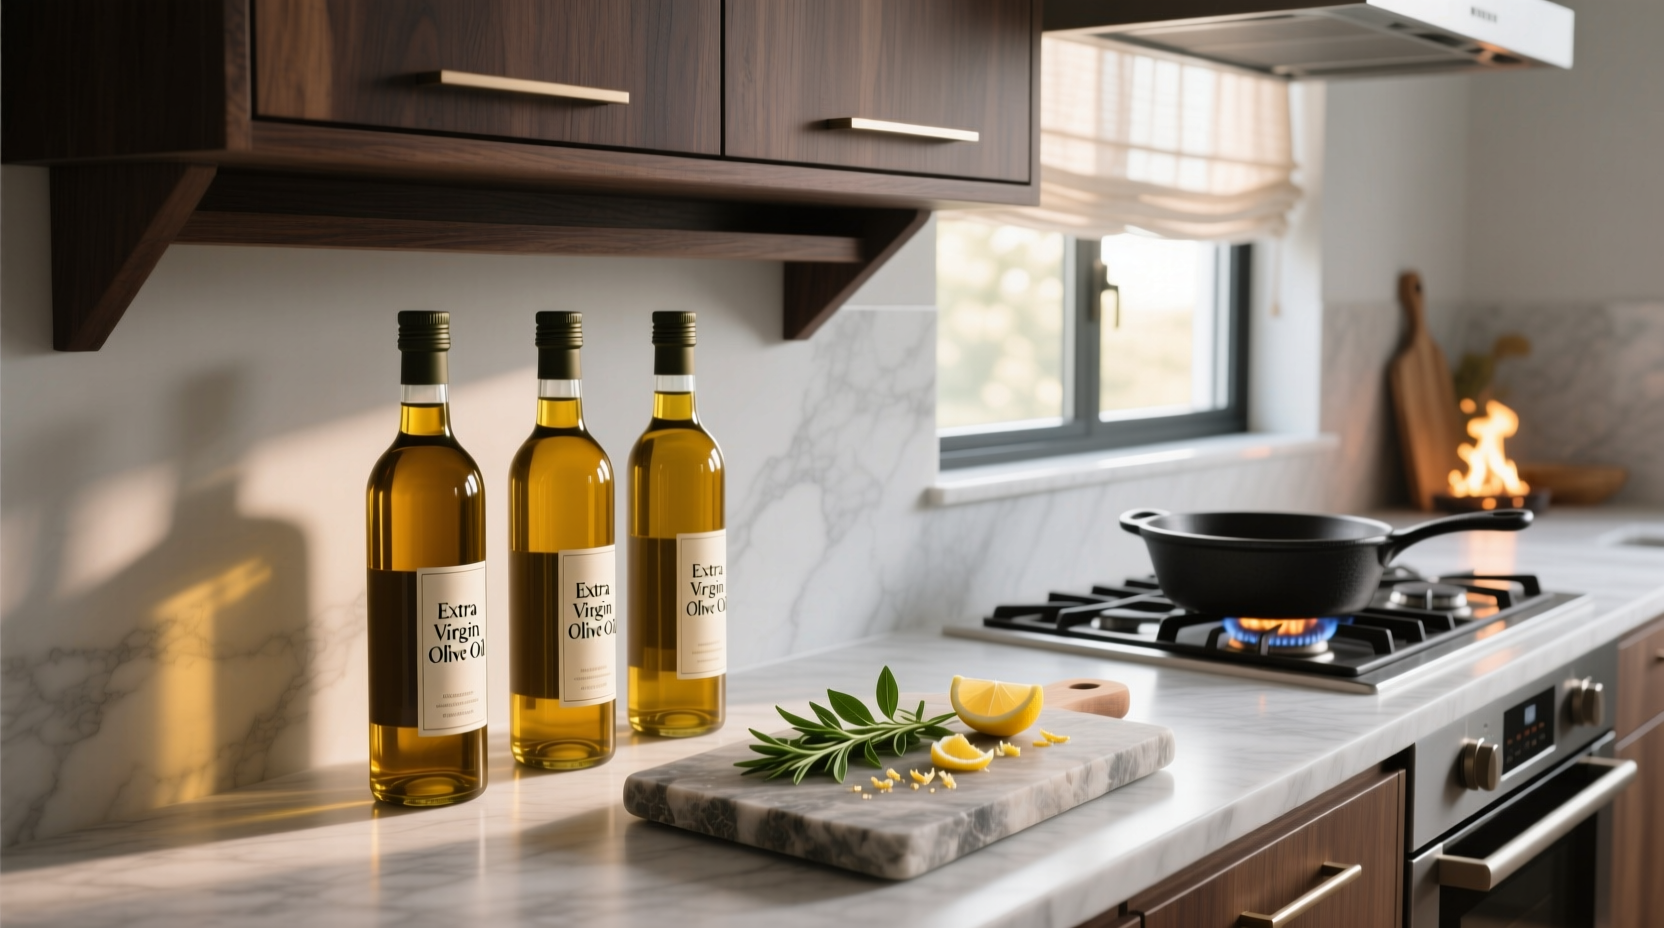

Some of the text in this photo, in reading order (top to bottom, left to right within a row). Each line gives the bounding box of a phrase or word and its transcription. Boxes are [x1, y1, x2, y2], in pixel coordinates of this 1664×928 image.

[692, 563, 723, 578] Extra
[576, 582, 610, 599] Extra
[438, 602, 477, 620] Extra
[573, 600, 612, 622] Virgin
[434, 621, 480, 643] Virgin
[568, 621, 602, 640] Olive
[428, 644, 467, 664] Olive
